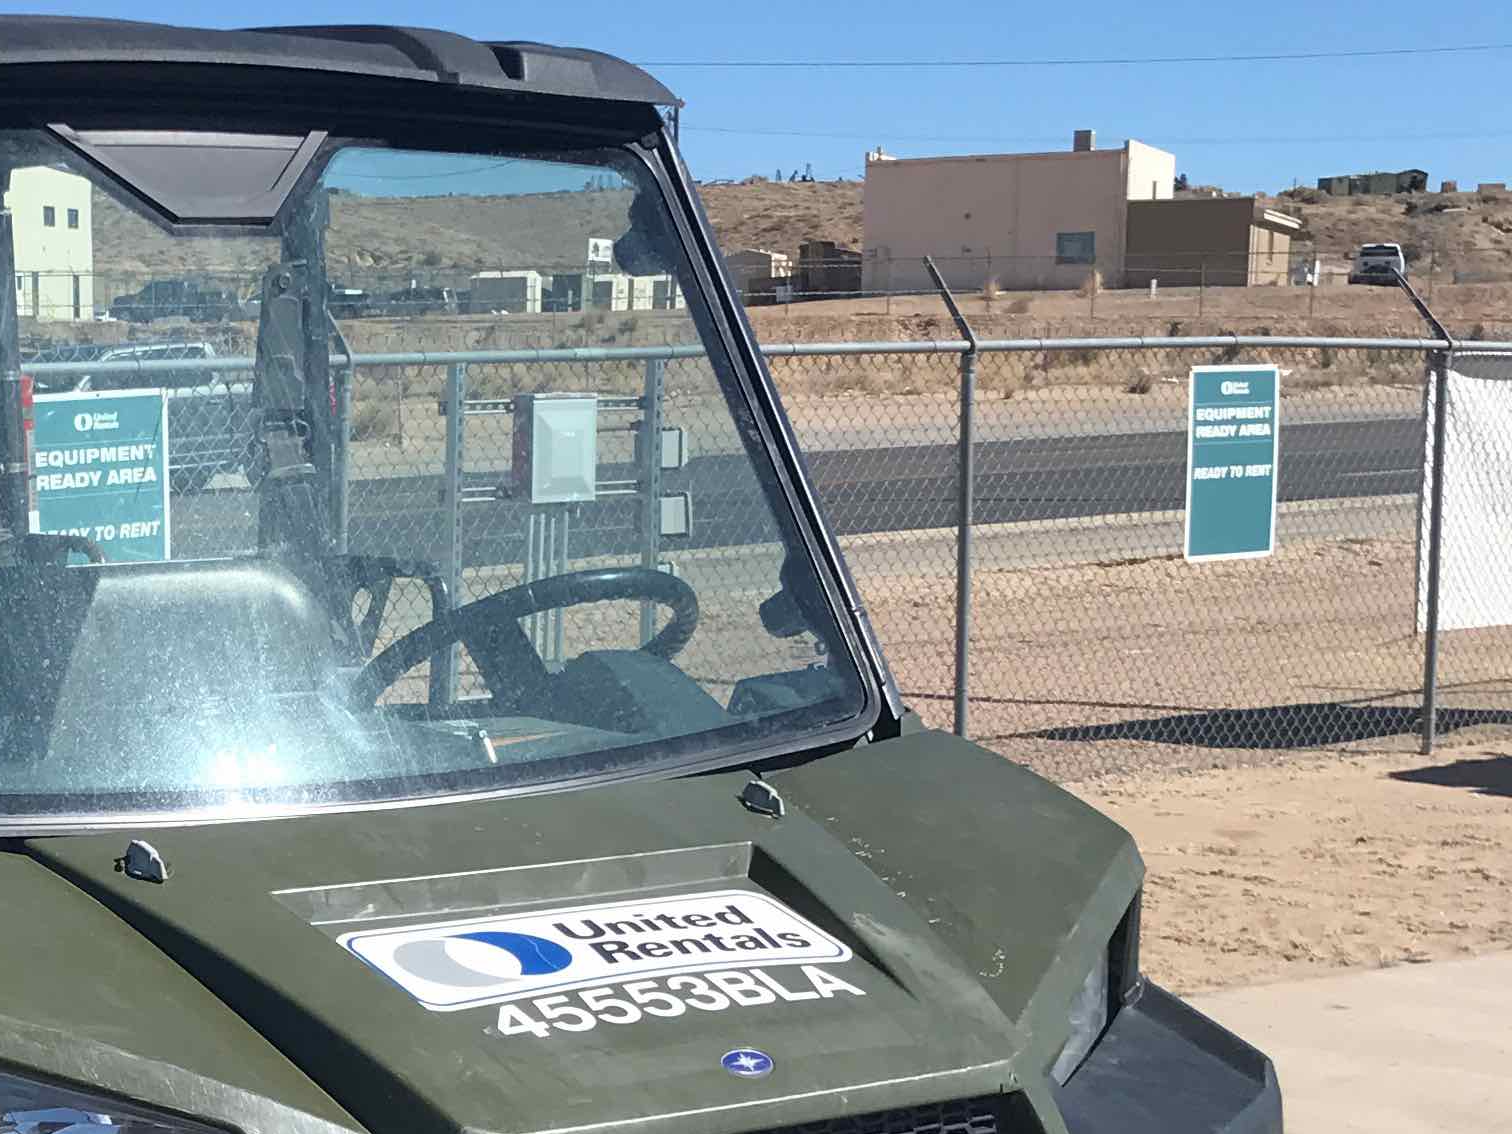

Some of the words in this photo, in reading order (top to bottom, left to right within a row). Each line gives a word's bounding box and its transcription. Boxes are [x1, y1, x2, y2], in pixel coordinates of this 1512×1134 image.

[1195, 406, 1272, 421] EQUIPMENT
[35, 444, 157, 468] EQUIPMENT
[36, 471, 102, 491] READY
[107, 466, 157, 485] AREA
[94, 525, 115, 541] TO
[119, 521, 161, 538] RENT
[552, 905, 754, 940] United
[589, 927, 811, 964] Rentals
[497, 965, 867, 1038] 45553BLA
